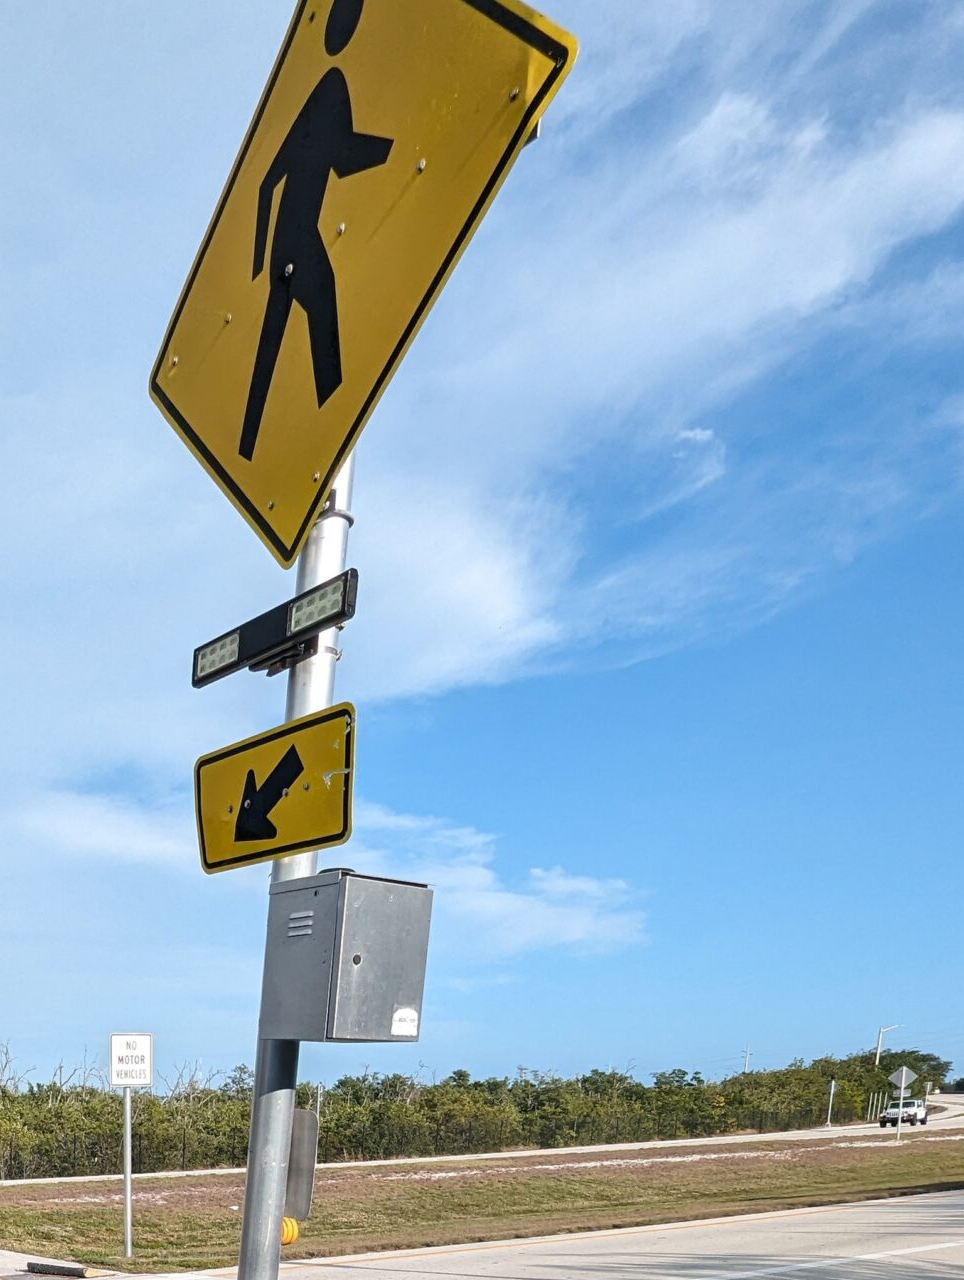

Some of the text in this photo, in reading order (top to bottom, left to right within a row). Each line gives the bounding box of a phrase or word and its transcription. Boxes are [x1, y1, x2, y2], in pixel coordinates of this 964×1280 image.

[126, 1040, 137, 1051] NO
[117, 1055, 145, 1065] MOTOR
[116, 1069, 146, 1079] VEHICLES
